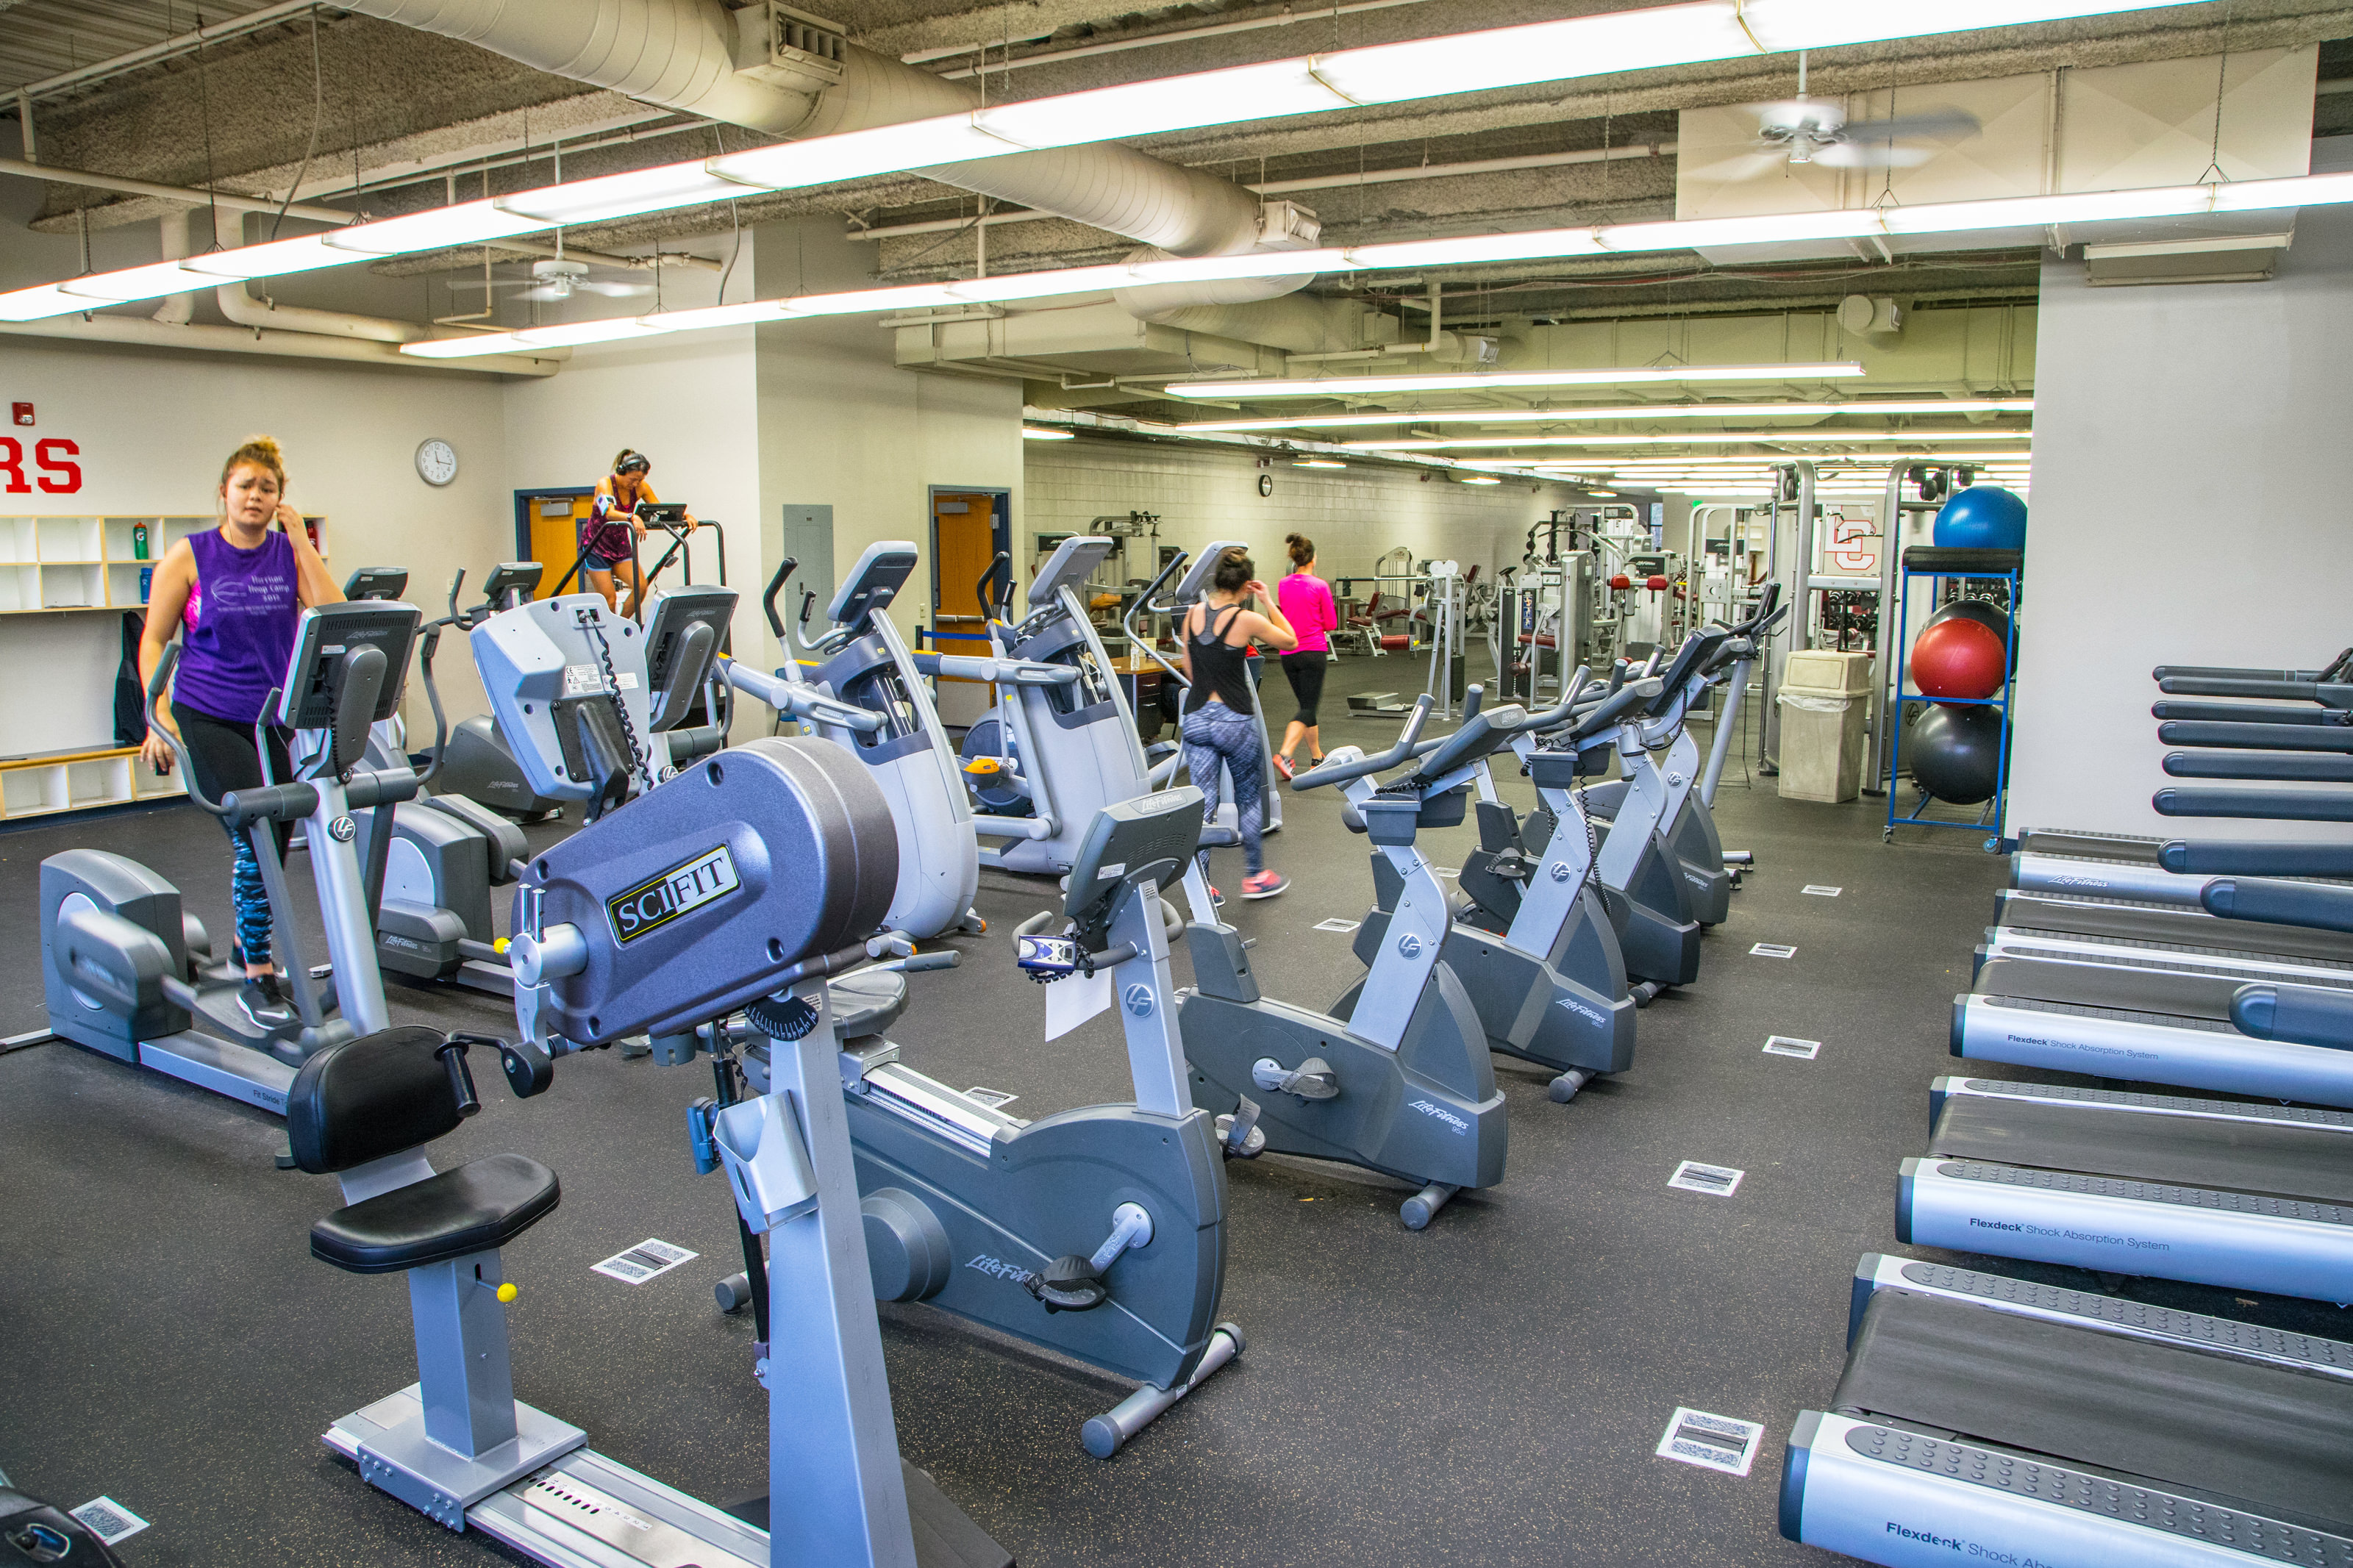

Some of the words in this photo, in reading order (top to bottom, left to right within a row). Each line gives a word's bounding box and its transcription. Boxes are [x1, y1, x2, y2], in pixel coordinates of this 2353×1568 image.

[618, 856, 724, 932] SCIFIT
[2050, 1039, 2077, 1050] Shock
[2078, 1044, 2124, 1056] Absorption
[2127, 1049, 2159, 1060] System
[2026, 1225, 2061, 1237] Shock
[2063, 1229, 2124, 1246] Absorption
[2127, 1238, 2170, 1251] System
[1968, 1543, 2018, 1566] Shock
